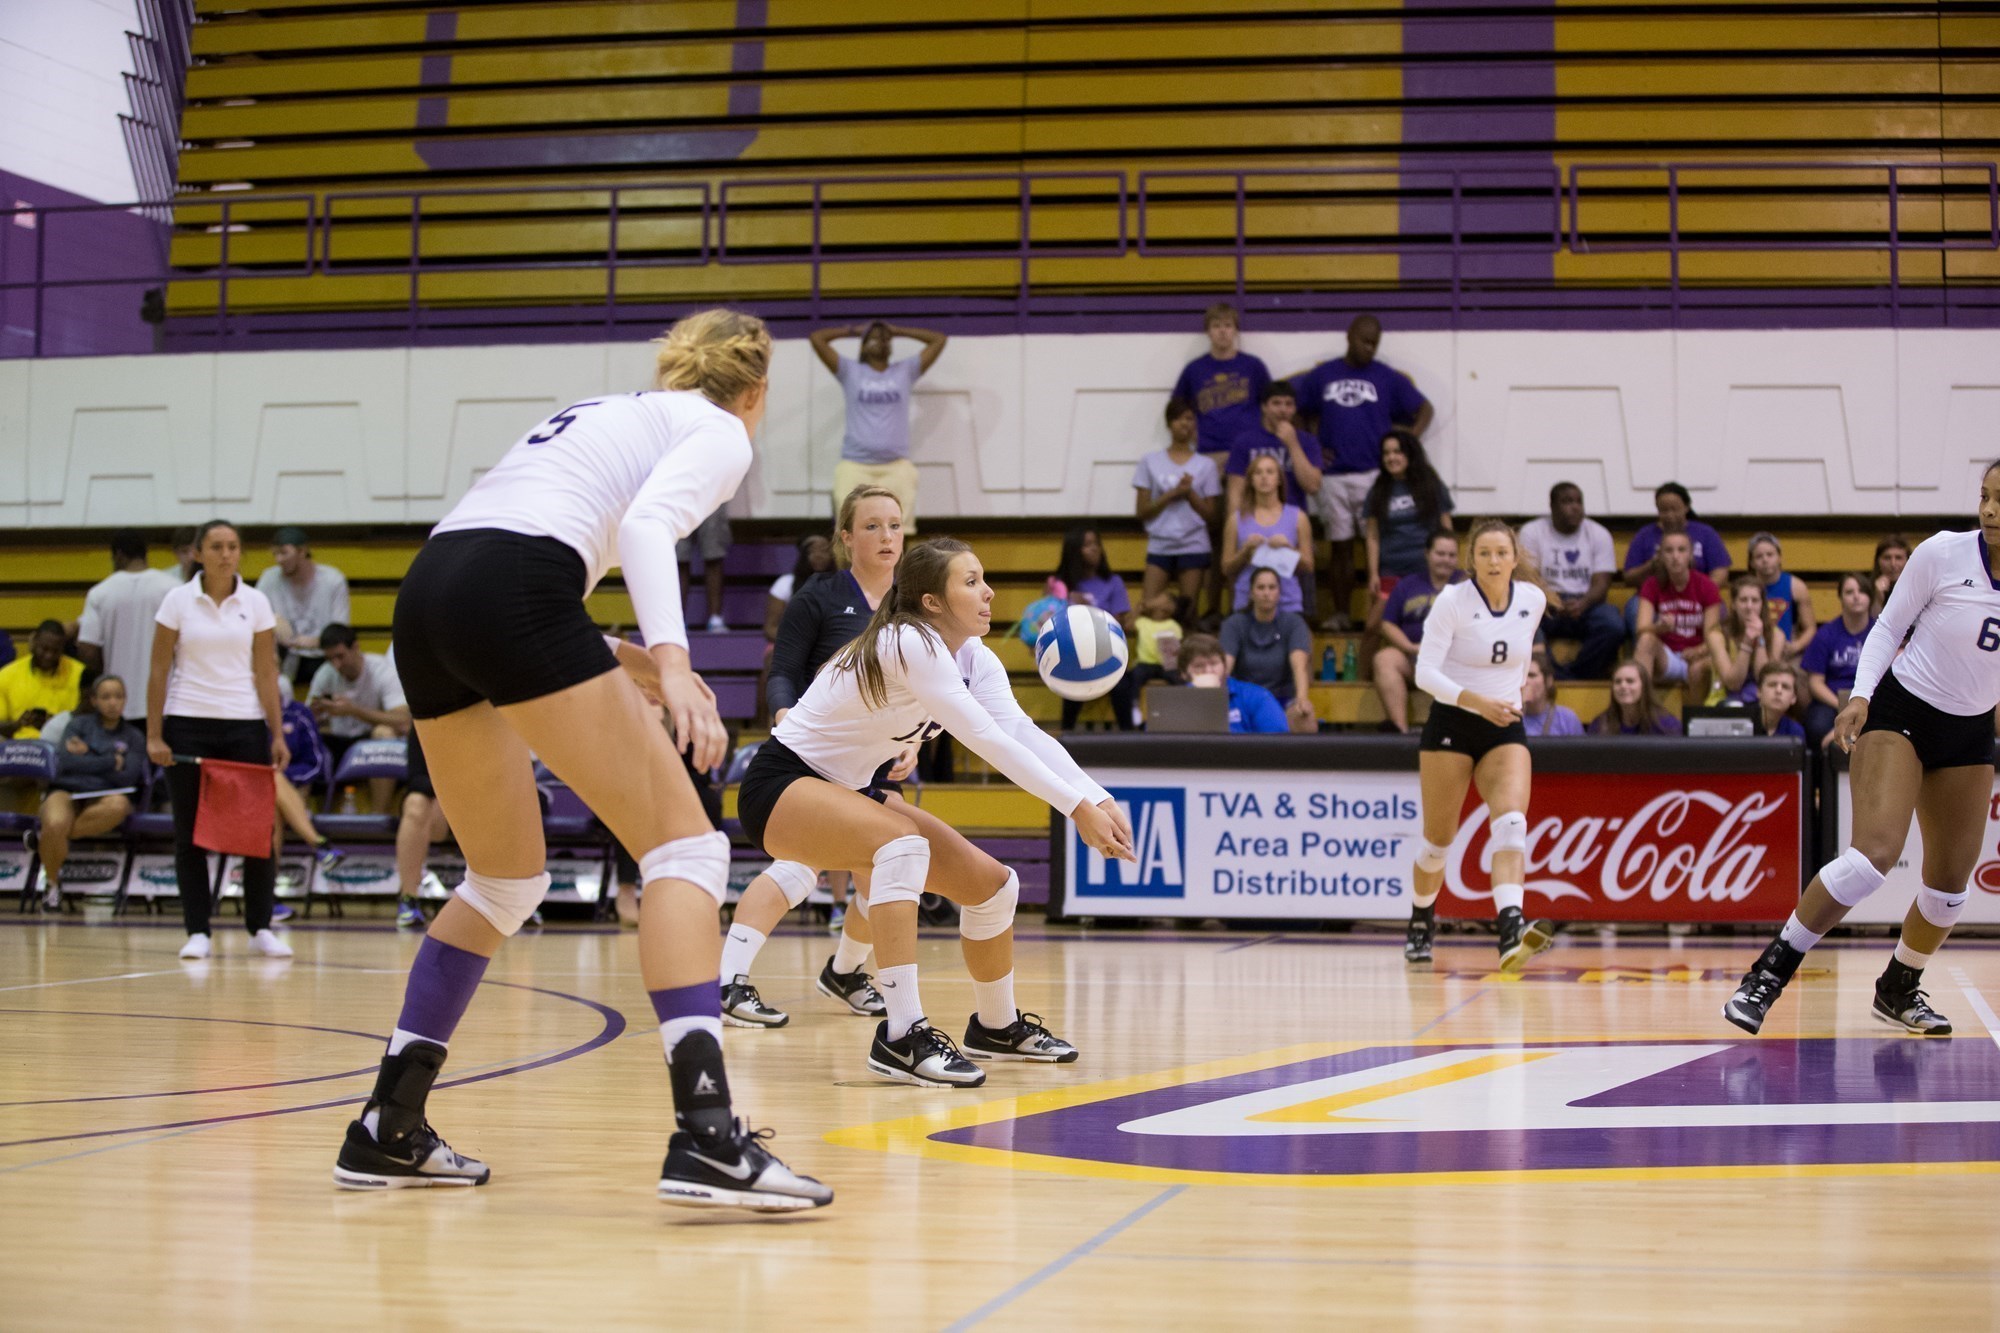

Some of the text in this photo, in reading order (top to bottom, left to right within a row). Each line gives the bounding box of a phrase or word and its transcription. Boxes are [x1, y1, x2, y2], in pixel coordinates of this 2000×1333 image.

[527, 402, 602, 444] 5
[1976, 616, 2000, 652] 6
[1491, 640, 1508, 664] 8
[1199, 792, 1418, 820] TVA & Shoals
[1214, 831, 1402, 859] Area Power
[1213, 869, 1404, 896] Distributors
